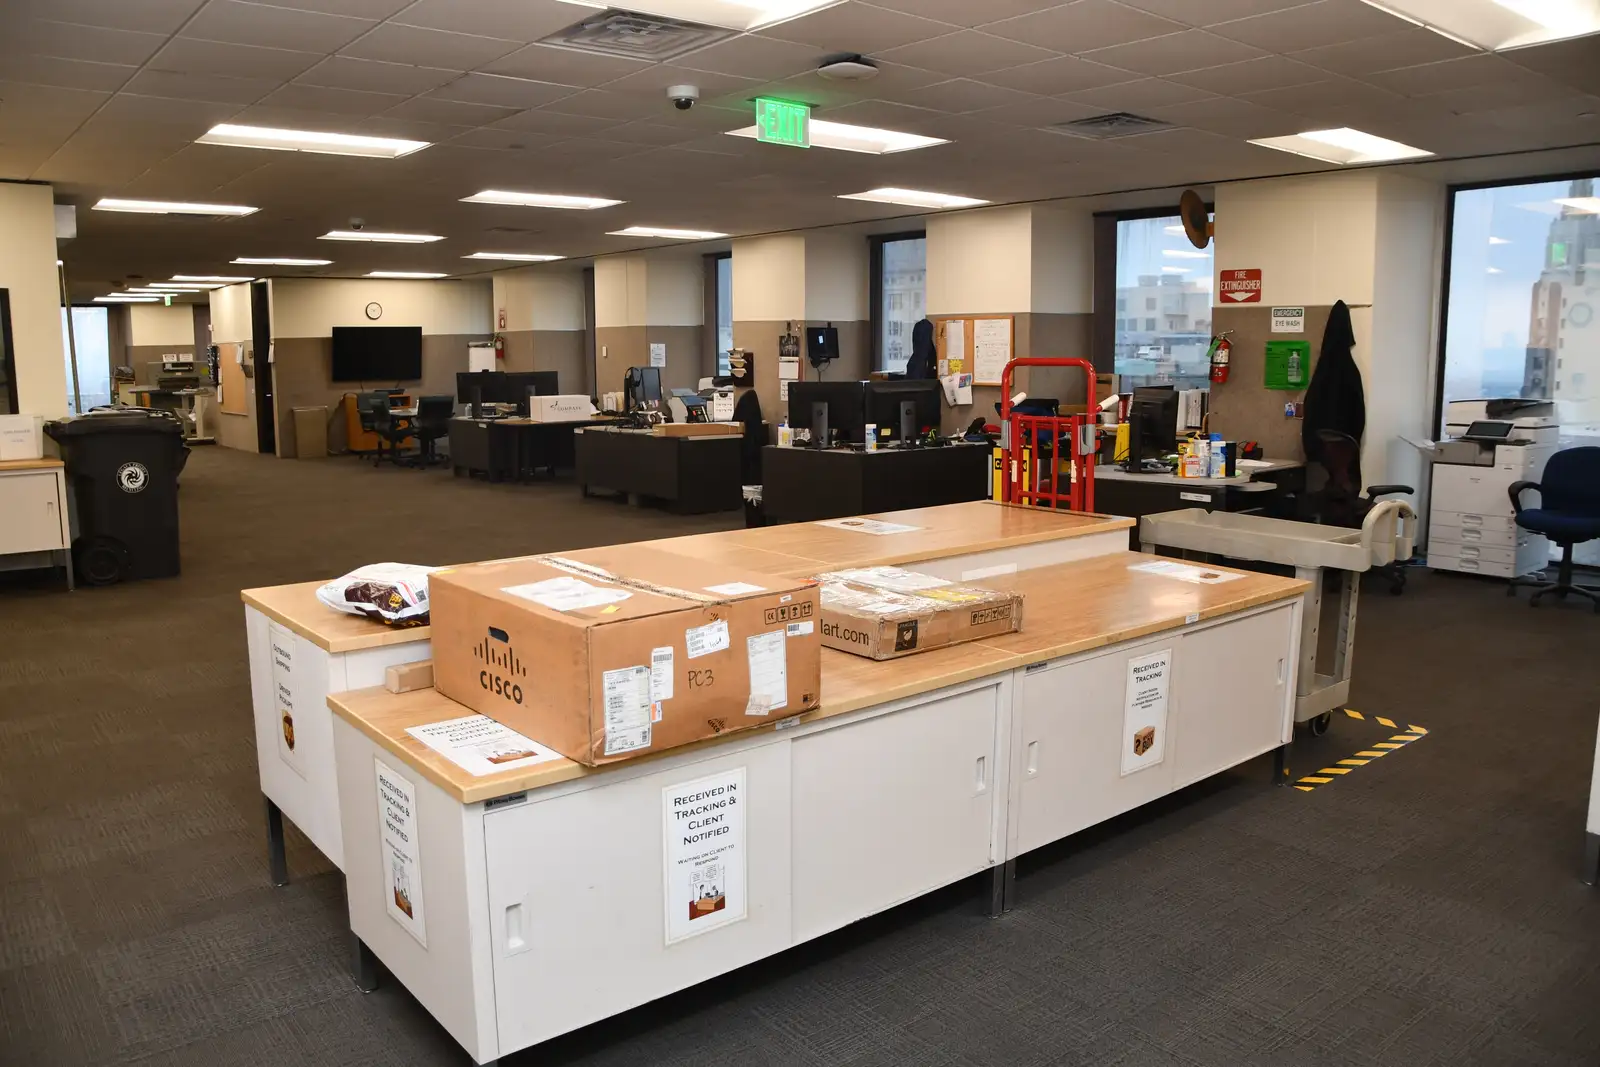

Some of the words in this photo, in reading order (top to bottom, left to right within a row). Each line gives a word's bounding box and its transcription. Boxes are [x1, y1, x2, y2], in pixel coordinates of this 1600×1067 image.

[765, 103, 805, 142] EXIT
[1234, 270, 1247, 279] FIRE
[1220, 280, 1261, 290] EXTINGUISHER
[1274, 309, 1302, 317] EMERGENCY
[1133, 662, 1160, 674] RECEIVED
[1135, 671, 1162, 683] TRACKING
[480, 670, 523, 704] CISCO
[688, 669, 714, 689] PC3
[379, 774, 403, 798] RECEIVED
[404, 793, 409, 803] IN
[674, 786, 725, 807] RECEIVED
[727, 783, 737, 792] IN
[381, 788, 405, 813] TRACKING
[405, 807, 410, 817] &
[674, 799, 726, 820] TRACKING
[728, 796, 737, 805] &
[387, 806, 404, 825] CLIENT
[688, 814, 725, 830] CLIENT
[386, 817, 408, 843] NOTIFIED
[683, 825, 730, 845] NOTIFIED
[678, 854, 700, 864] WAITING
[710, 846, 727, 855] CLIENT
